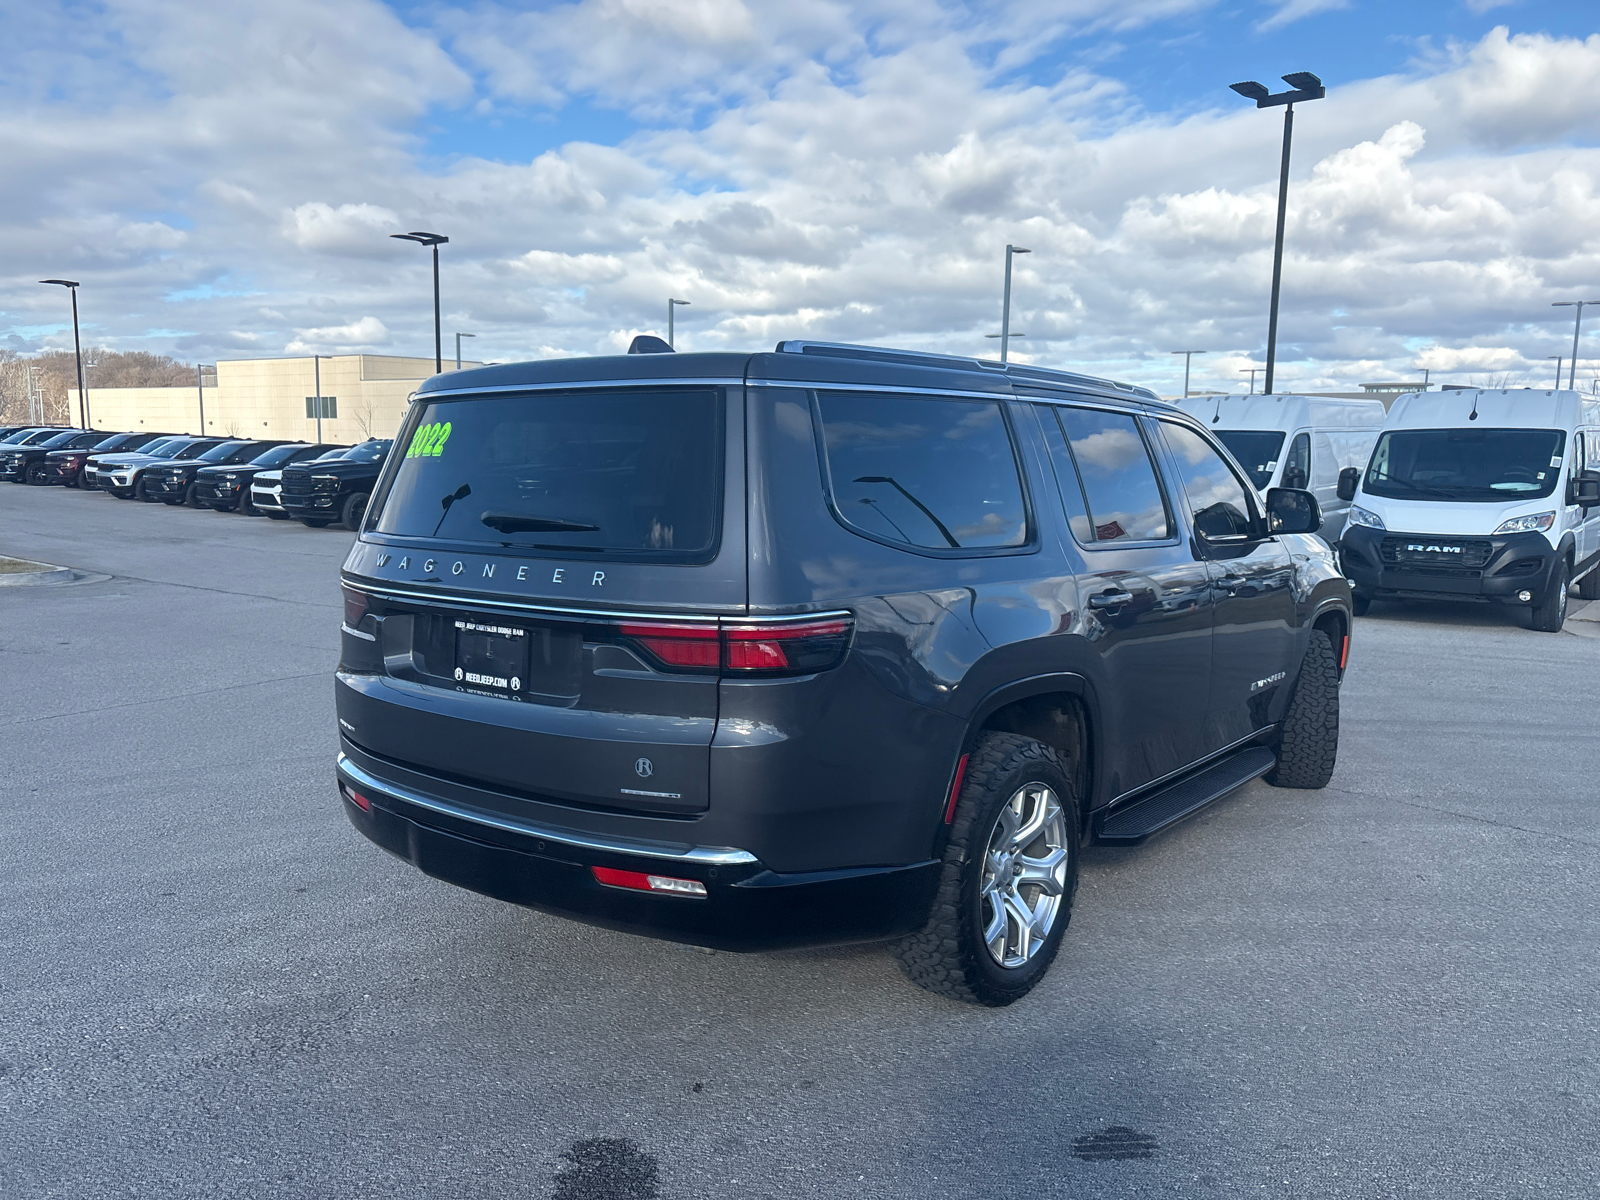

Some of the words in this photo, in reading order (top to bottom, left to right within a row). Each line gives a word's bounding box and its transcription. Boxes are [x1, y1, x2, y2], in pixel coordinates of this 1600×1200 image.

[406, 422, 452, 458] 2022
[1408, 544, 1460, 553] RAM
[376, 553, 608, 586] WAGONEER
[476, 624, 497, 633] CHRYSLER
[498, 626, 512, 635] DODGE
[513, 628, 524, 636] RAM
[465, 672, 508, 688] REEDJEEP.COM
